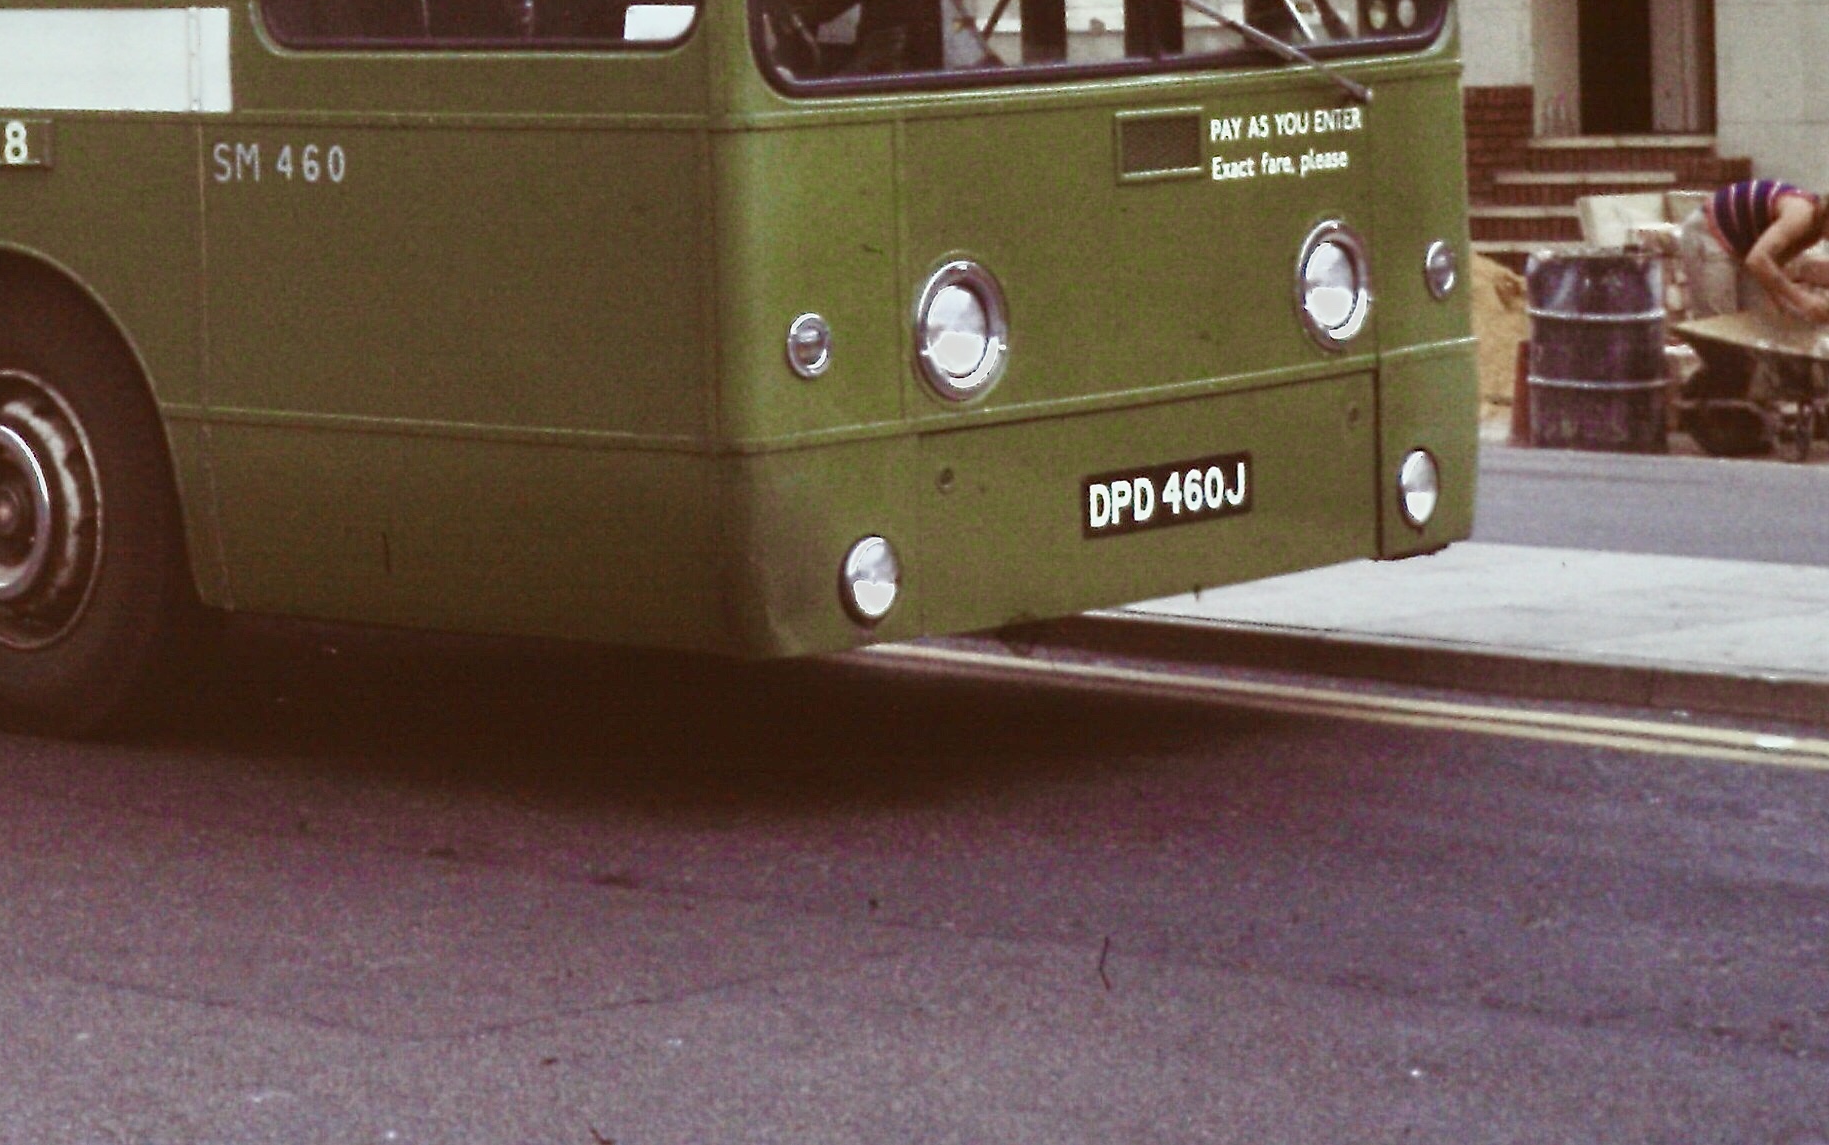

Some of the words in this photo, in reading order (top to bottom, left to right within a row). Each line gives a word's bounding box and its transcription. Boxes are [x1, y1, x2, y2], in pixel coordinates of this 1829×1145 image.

[4, 120, 29, 165] 8
[1210, 117, 1243, 143] PAY
[1247, 114, 1270, 140] AS
[1274, 111, 1310, 137] YOU
[1314, 107, 1362, 133] ENTER
[212, 142, 262, 183] SM
[276, 142, 347, 184] 460
[1211, 156, 1255, 181] Exact
[1300, 149, 1348, 177] please
[1089, 477, 1156, 529] DPD
[1162, 461, 1246, 515] 460J
